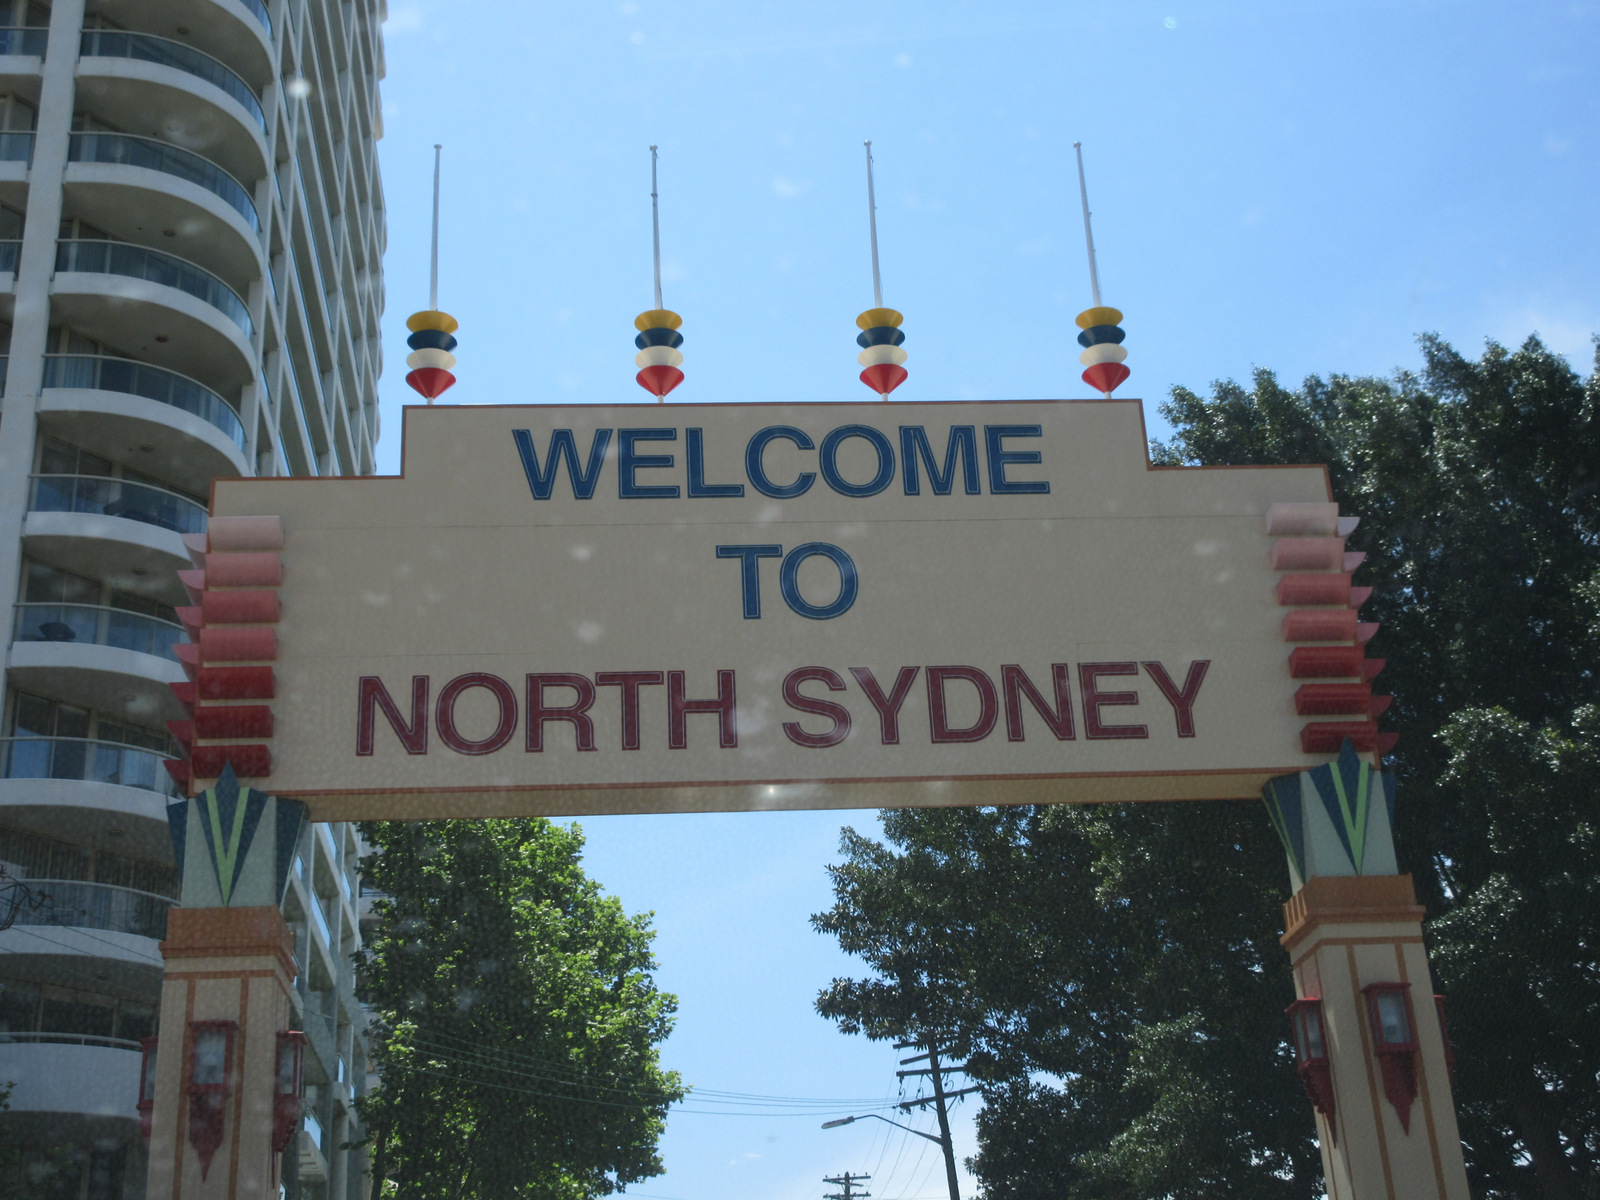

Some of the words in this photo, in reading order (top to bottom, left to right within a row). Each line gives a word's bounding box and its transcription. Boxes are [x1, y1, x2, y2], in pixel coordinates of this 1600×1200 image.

[512, 424, 1051, 501] WELCOME
[716, 541, 859, 621] TO
[356, 669, 737, 757] NORTH
[782, 659, 1210, 749] SYDNEY
